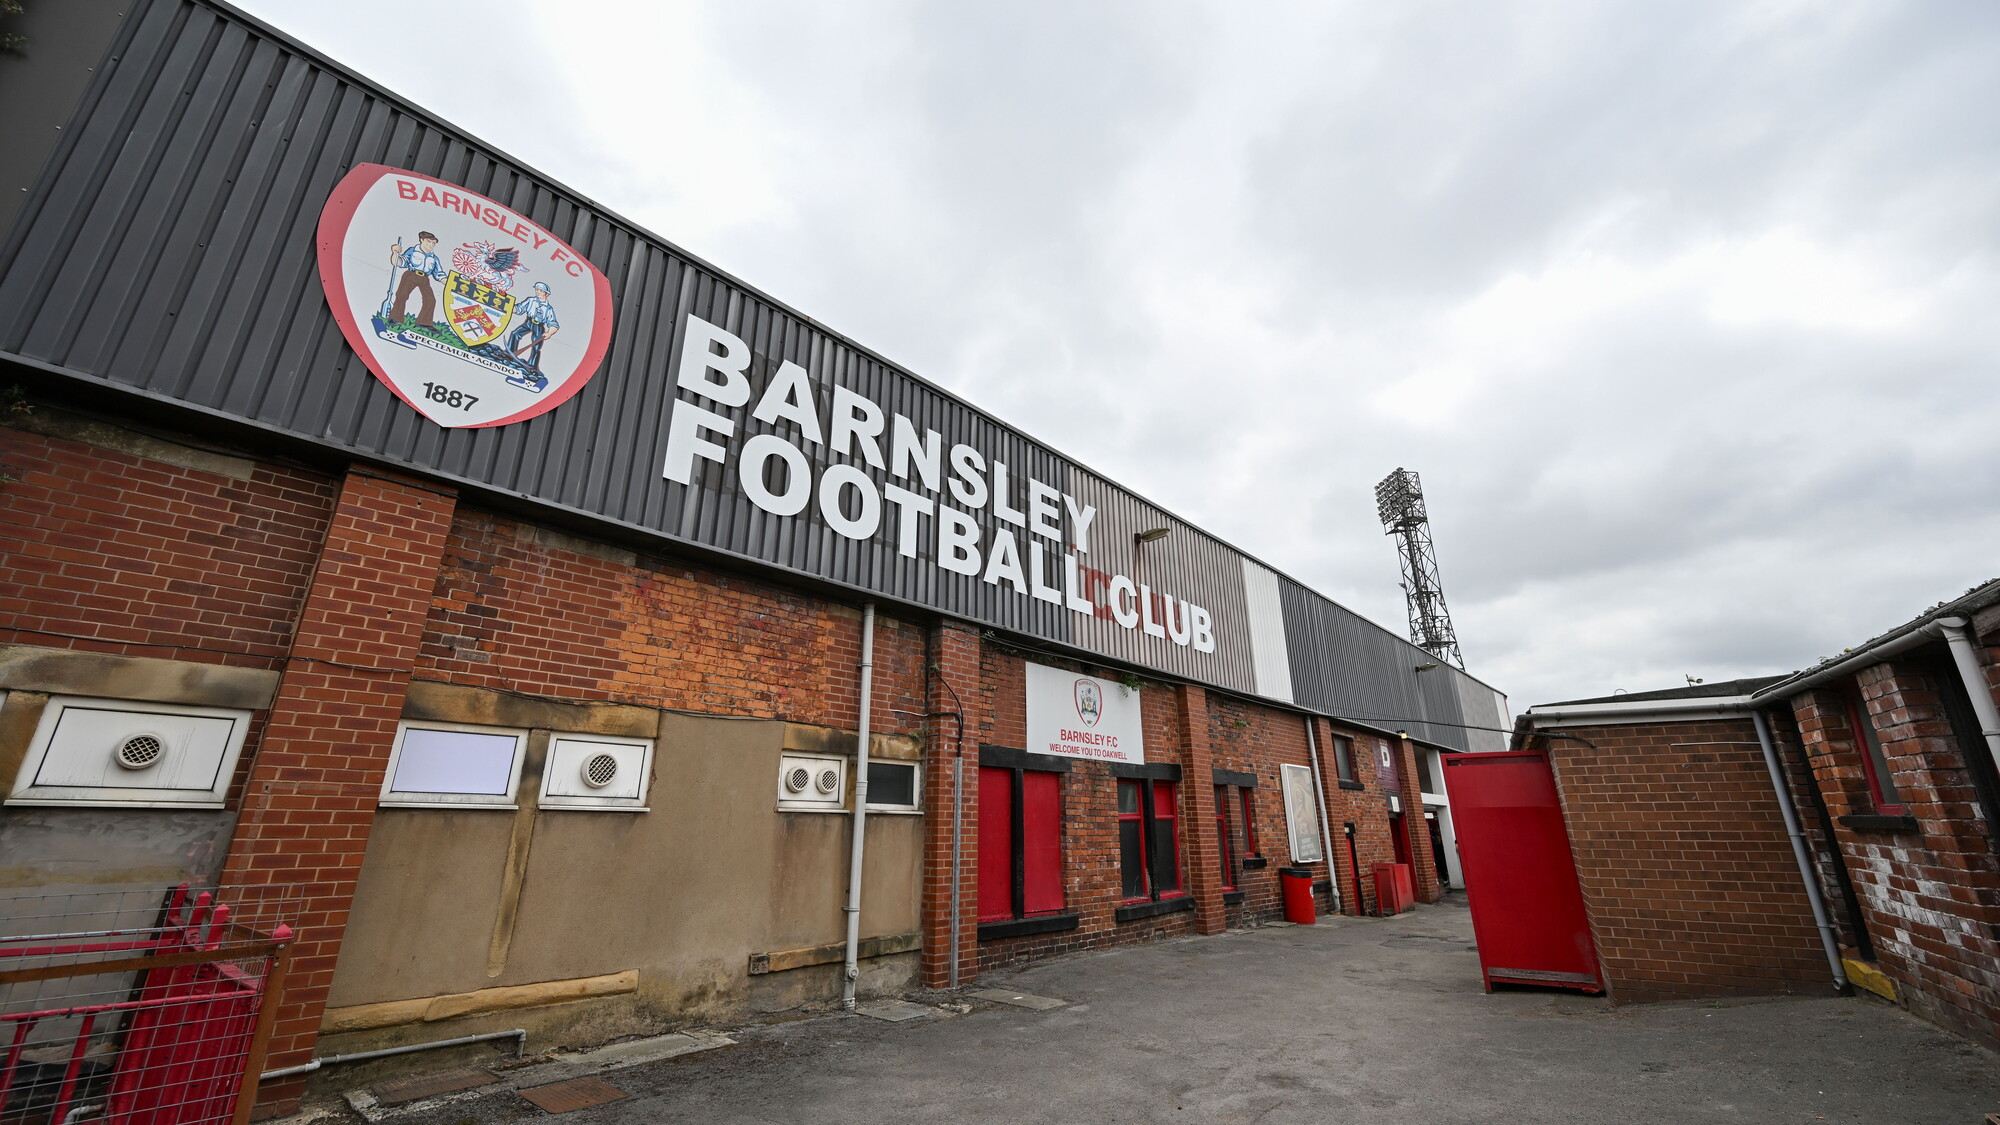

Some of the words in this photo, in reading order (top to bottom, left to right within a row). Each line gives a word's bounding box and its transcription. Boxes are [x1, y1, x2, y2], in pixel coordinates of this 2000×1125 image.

[396, 179, 549, 250] BARNSLEY
[550, 247, 585, 278] FC
[408, 333, 470, 360] SPECTEMUR
[475, 357, 516, 376] AGENDO
[422, 381, 480, 412] 1887
[677, 313, 1097, 553] BARNSLEY
[662, 397, 1094, 616] FOOTBALL
[1109, 574, 1215, 654] CLUB
[1049, 743, 1080, 755] WELCOME
[1081, 747, 1093, 757] YOU
[1094, 748, 1101, 757] TO
[1102, 749, 1128, 760] OAKWELL
[1060, 728, 1105, 746] BARNSLEY
[1106, 735, 1118, 748] F.C
[1380, 745, 1391, 768] D
